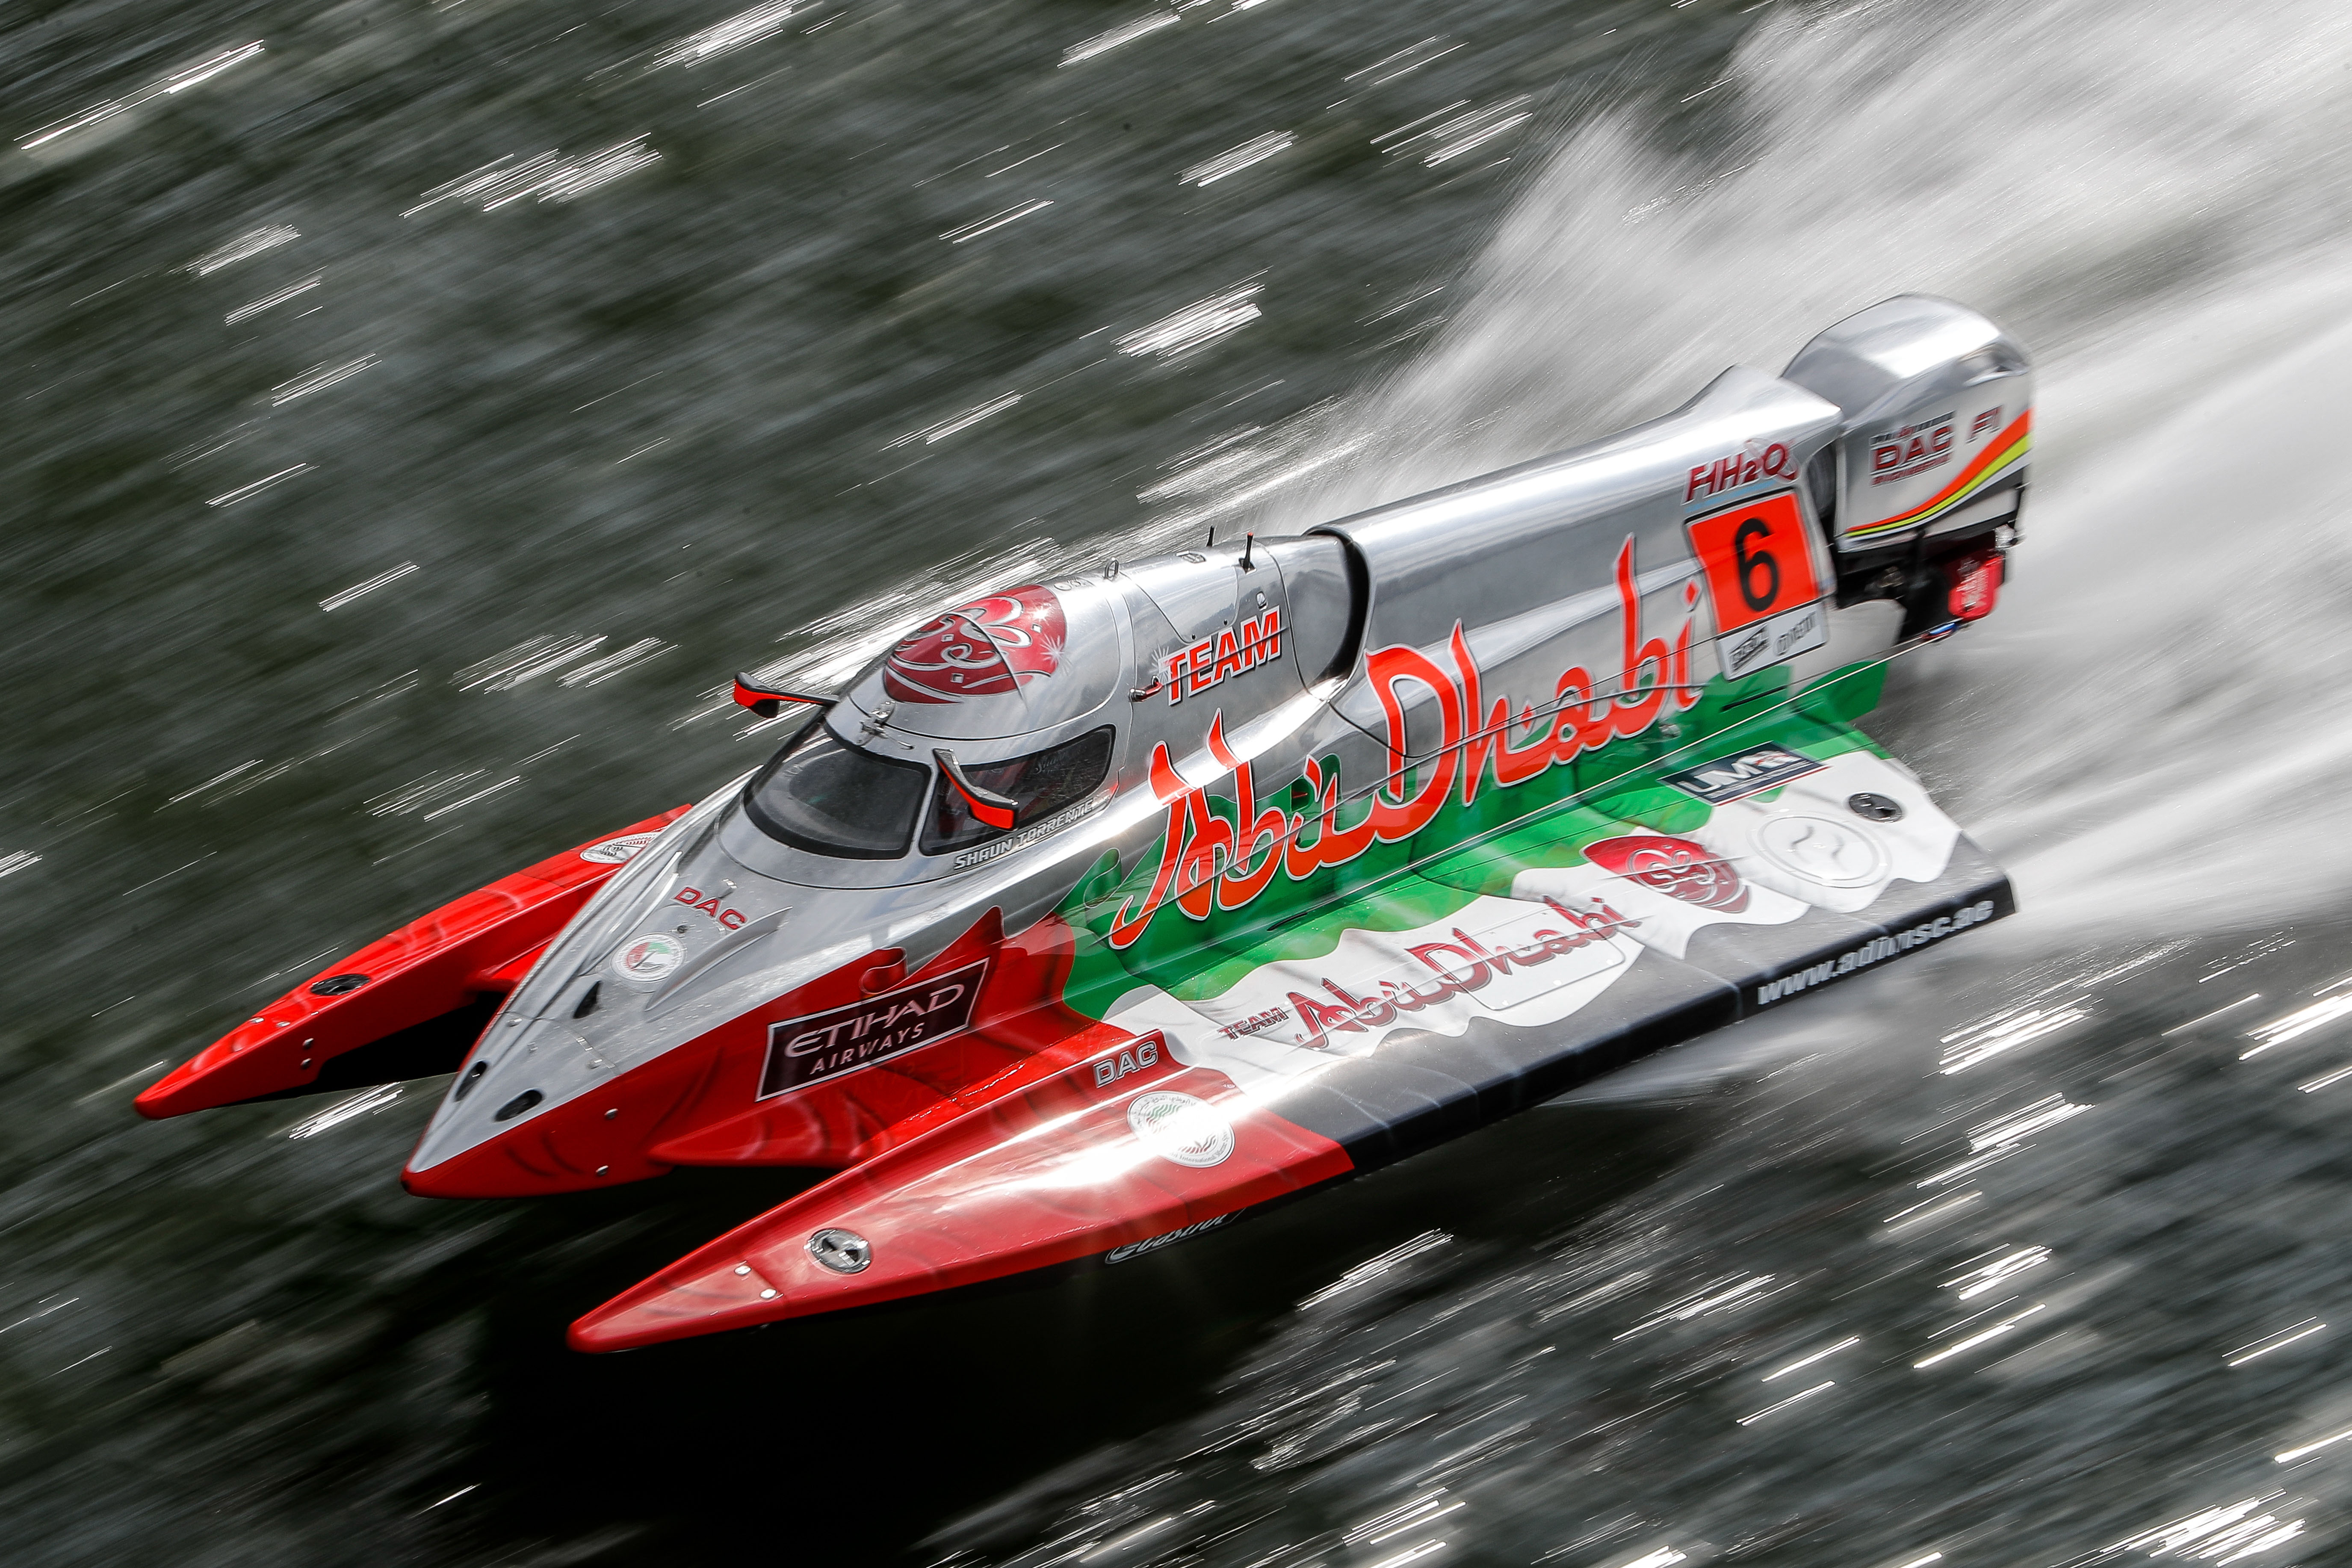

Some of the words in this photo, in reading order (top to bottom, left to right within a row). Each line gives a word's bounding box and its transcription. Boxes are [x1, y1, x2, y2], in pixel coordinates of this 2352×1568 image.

[1873, 423, 1955, 471] DAC
[1733, 517, 1779, 612] 6
[1158, 605, 1281, 706] TEAM
[954, 838, 1013, 870] SHAUN
[1016, 799, 1094, 846] TORRENTE
[673, 886, 747, 930] DAC
[784, 983, 965, 1058] ETIHAD
[1217, 1007, 1289, 1040] TEAM
[810, 1022, 926, 1075] AIRWAYS
[1093, 1040, 1158, 1089] DAC
